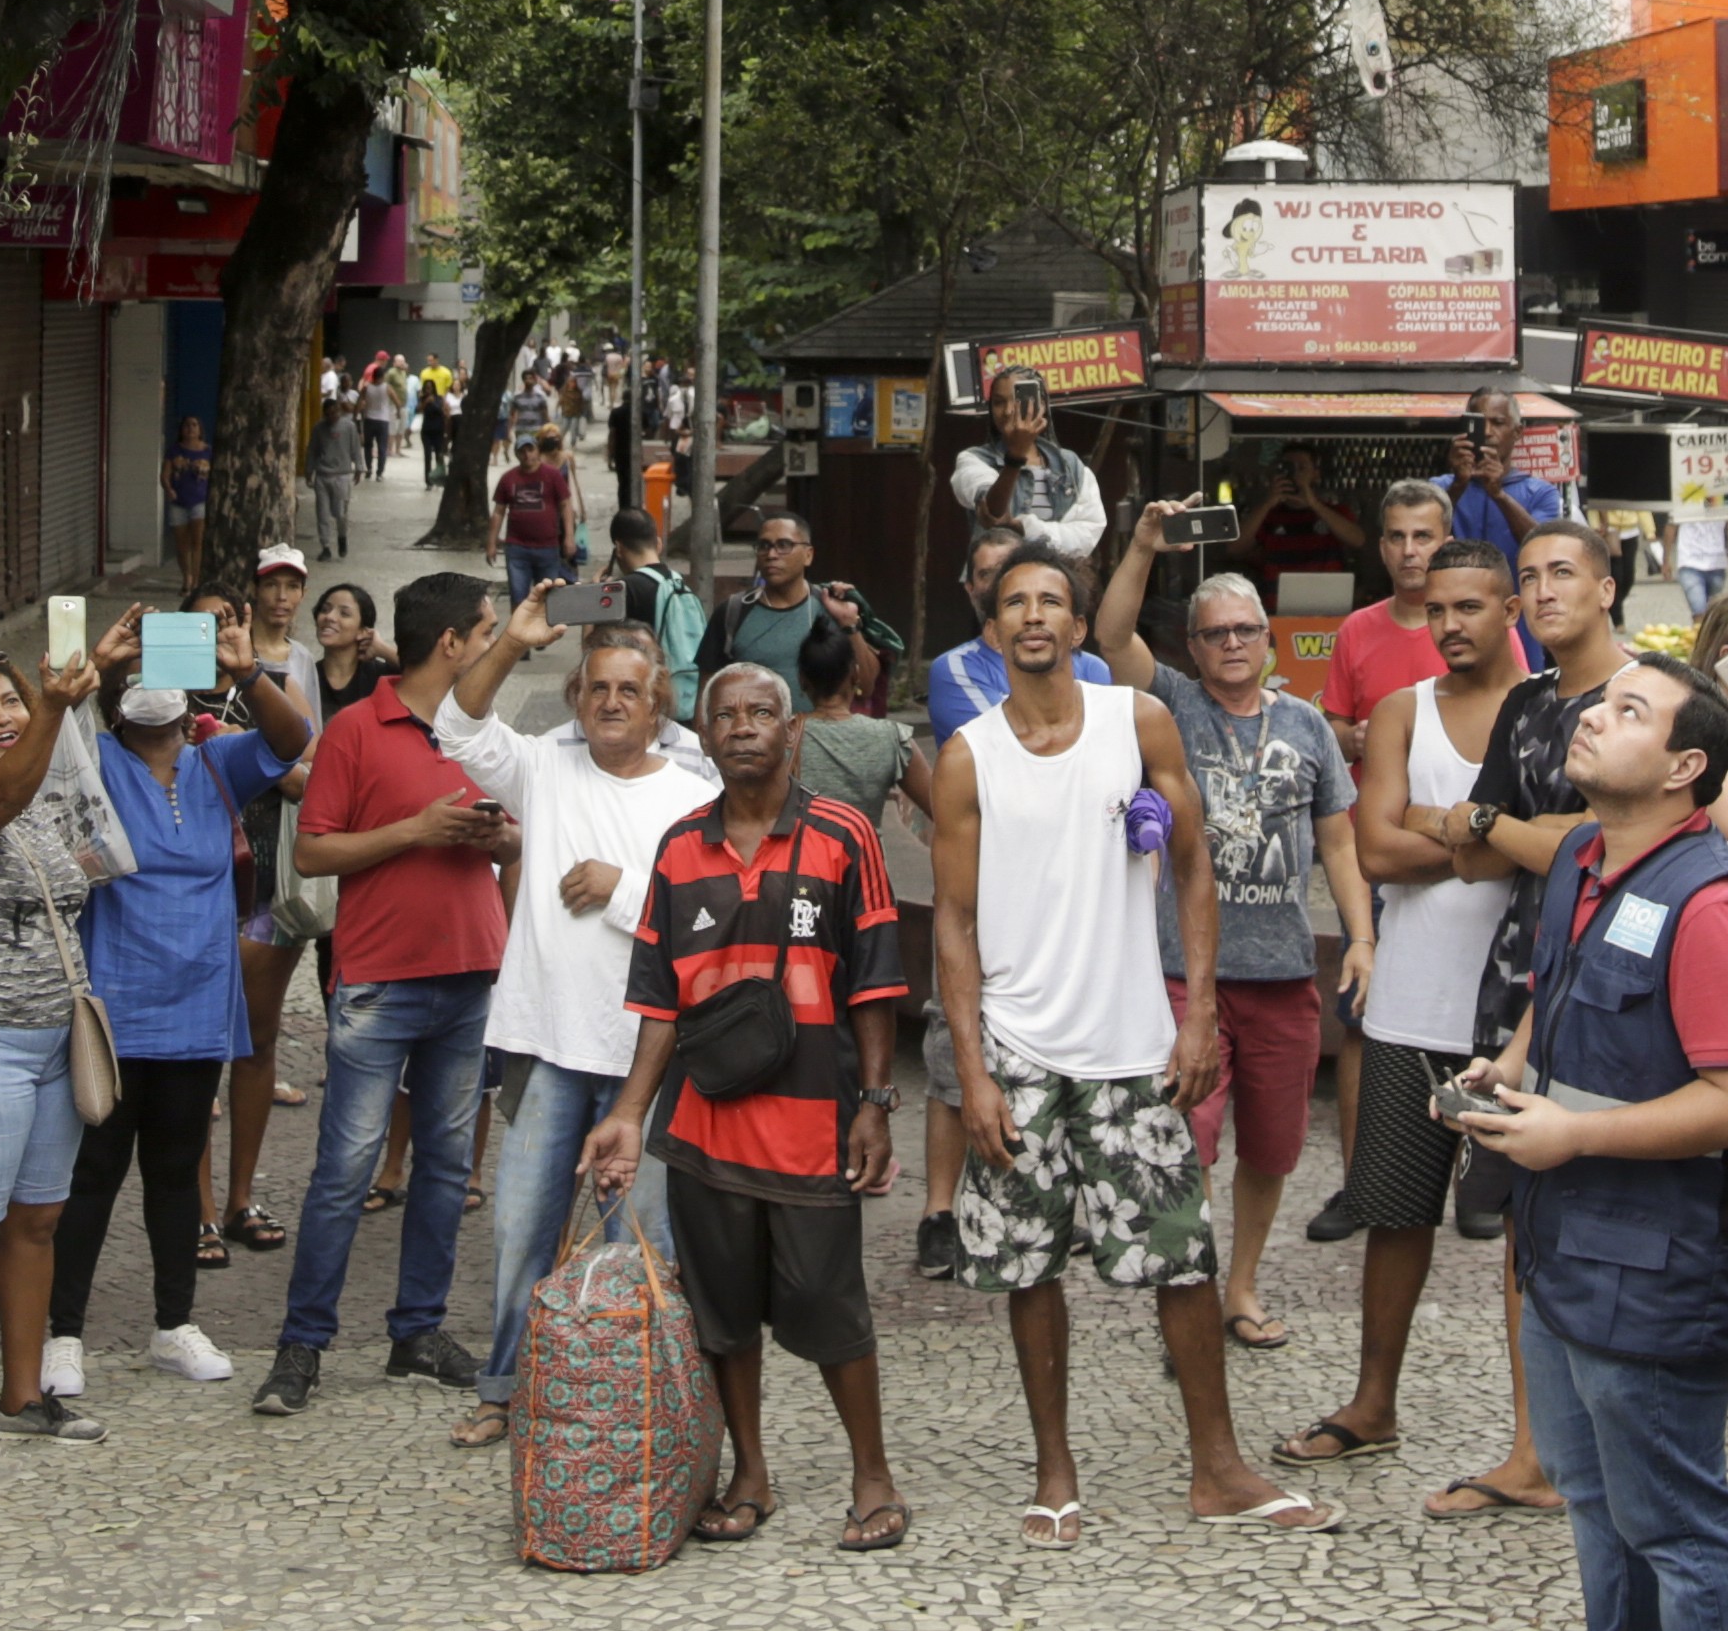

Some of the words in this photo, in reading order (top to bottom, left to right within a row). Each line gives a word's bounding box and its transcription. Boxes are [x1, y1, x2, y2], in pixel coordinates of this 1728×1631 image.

[1274, 200, 1313, 219] WJ
[1318, 200, 1445, 219] CHAVEIRO
[1697, 238, 1717, 254] be
[1290, 246, 1429, 265] CUTELARIA
[1218, 284, 1286, 299] AMOLA-SE
[1290, 285, 1308, 299] NA
[1311, 285, 1350, 299] HORA
[1387, 281, 1436, 299] CÓPIAS
[1440, 285, 1459, 299] NA
[1462, 285, 1501, 299] HORA
[1257, 301, 1318, 311] ALICATES
[1394, 301, 1445, 311] CHAVES
[1448, 301, 1502, 311] COMUNS
[1268, 311, 1308, 321] FACAS
[1254, 322, 1322, 332] TESOURAS
[1396, 322, 1446, 332] CHAVES
[1449, 322, 1466, 332] DE
[1469, 322, 1501, 332] LOJA
[1002, 337, 1100, 367] CHAVEIRO
[1104, 336, 1118, 358] E
[1610, 336, 1706, 368] CHAVEIRO
[1709, 349, 1722, 370] E
[1040, 362, 1122, 391] ELARIA
[1606, 362, 1719, 396] CUTELARIA
[1294, 634, 1337, 658] WJ
[1234, 883, 1284, 905] JOHN
